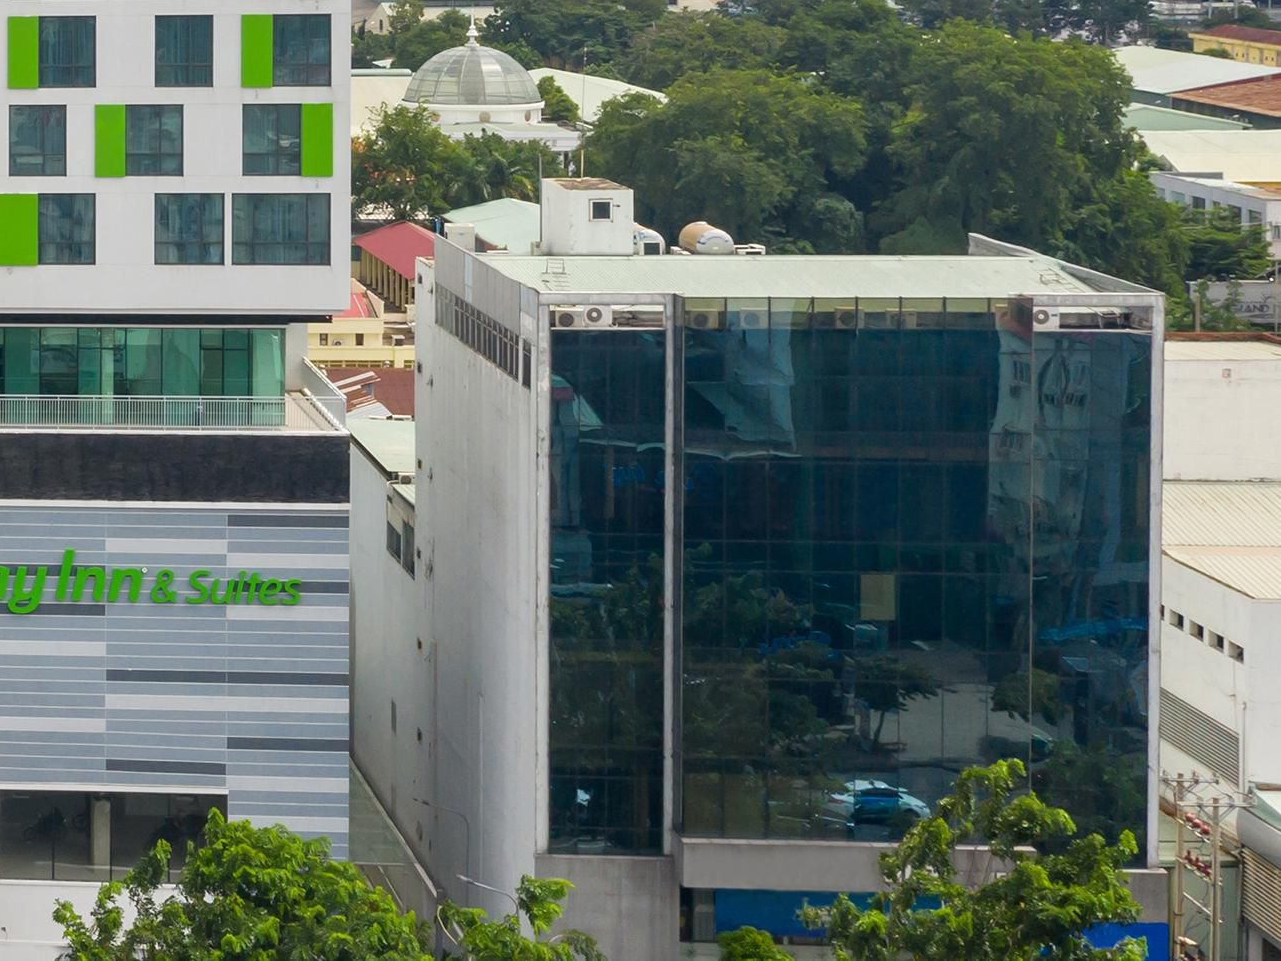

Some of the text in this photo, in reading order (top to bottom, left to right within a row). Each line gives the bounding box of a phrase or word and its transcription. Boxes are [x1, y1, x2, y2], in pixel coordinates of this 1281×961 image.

[55, 548, 143, 602] Inn
[149, 569, 177, 603] &
[184, 570, 303, 606] Suites
